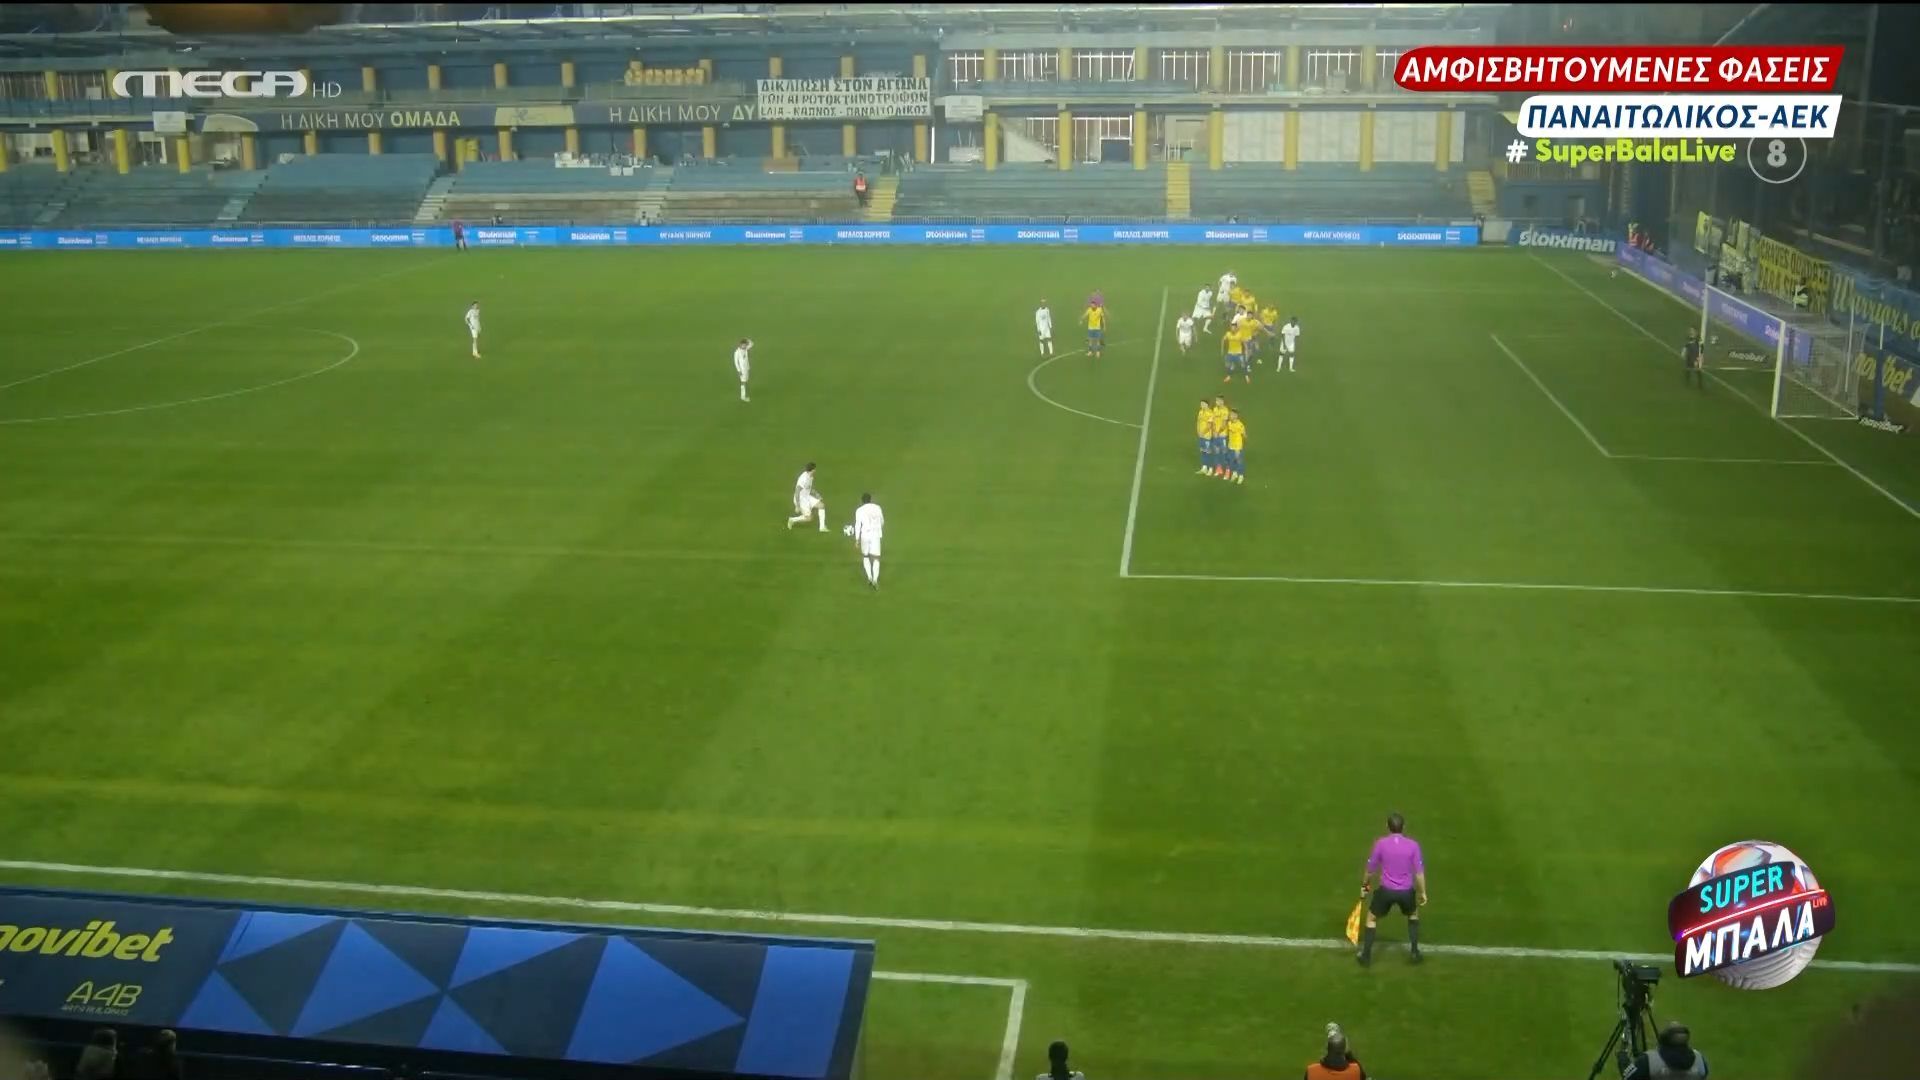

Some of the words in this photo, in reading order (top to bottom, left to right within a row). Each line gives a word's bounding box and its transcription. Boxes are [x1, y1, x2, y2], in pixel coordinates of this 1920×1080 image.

[834, 79, 873, 92] ΣΤΟΝ
[345, 112, 385, 128] ΜΟΥ
[390, 111, 461, 126] ΟΜΑΔΑ
[609, 106, 622, 122] Η
[628, 104, 671, 122] ΔΙΚΗ
[678, 104, 721, 121] ΜΟΥ
[66, 981, 143, 1008] A4B
